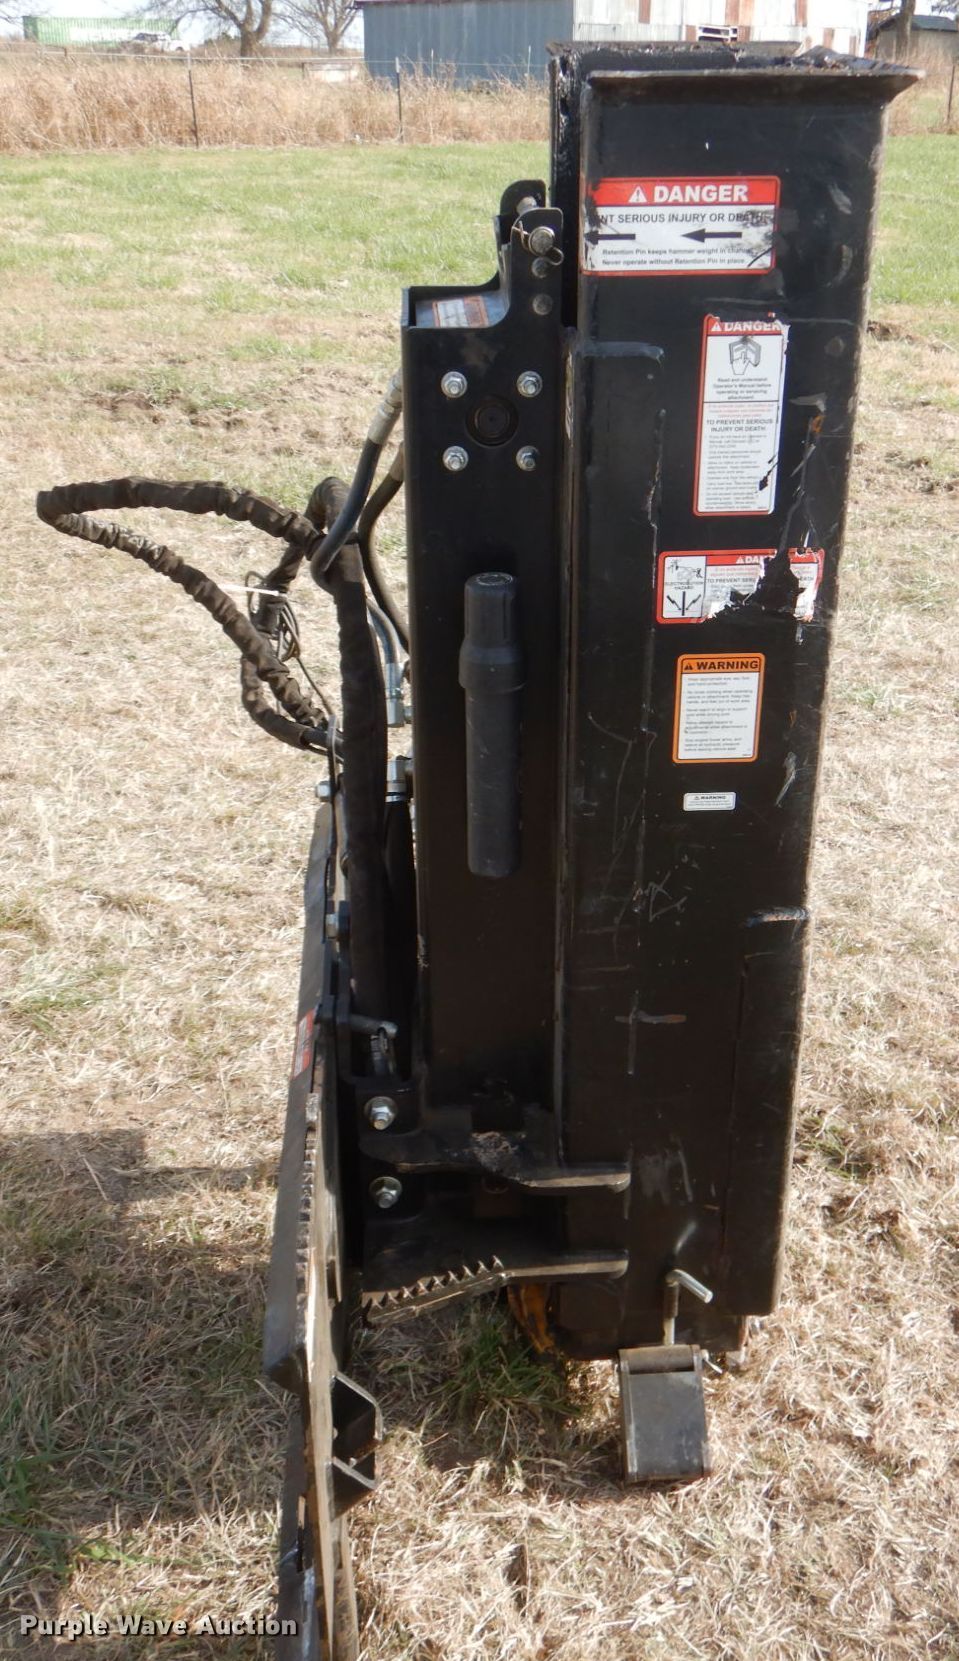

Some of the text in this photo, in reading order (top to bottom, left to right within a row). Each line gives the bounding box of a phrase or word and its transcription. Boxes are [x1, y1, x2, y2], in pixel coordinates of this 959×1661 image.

[654, 184, 749, 204] DANGER
[617, 213, 665, 224] SERIOUS
[668, 213, 707, 223] INJURY
[709, 213, 725, 223] OR
[724, 321, 782, 332] DANGER
[696, 660, 759, 671] WARNING
